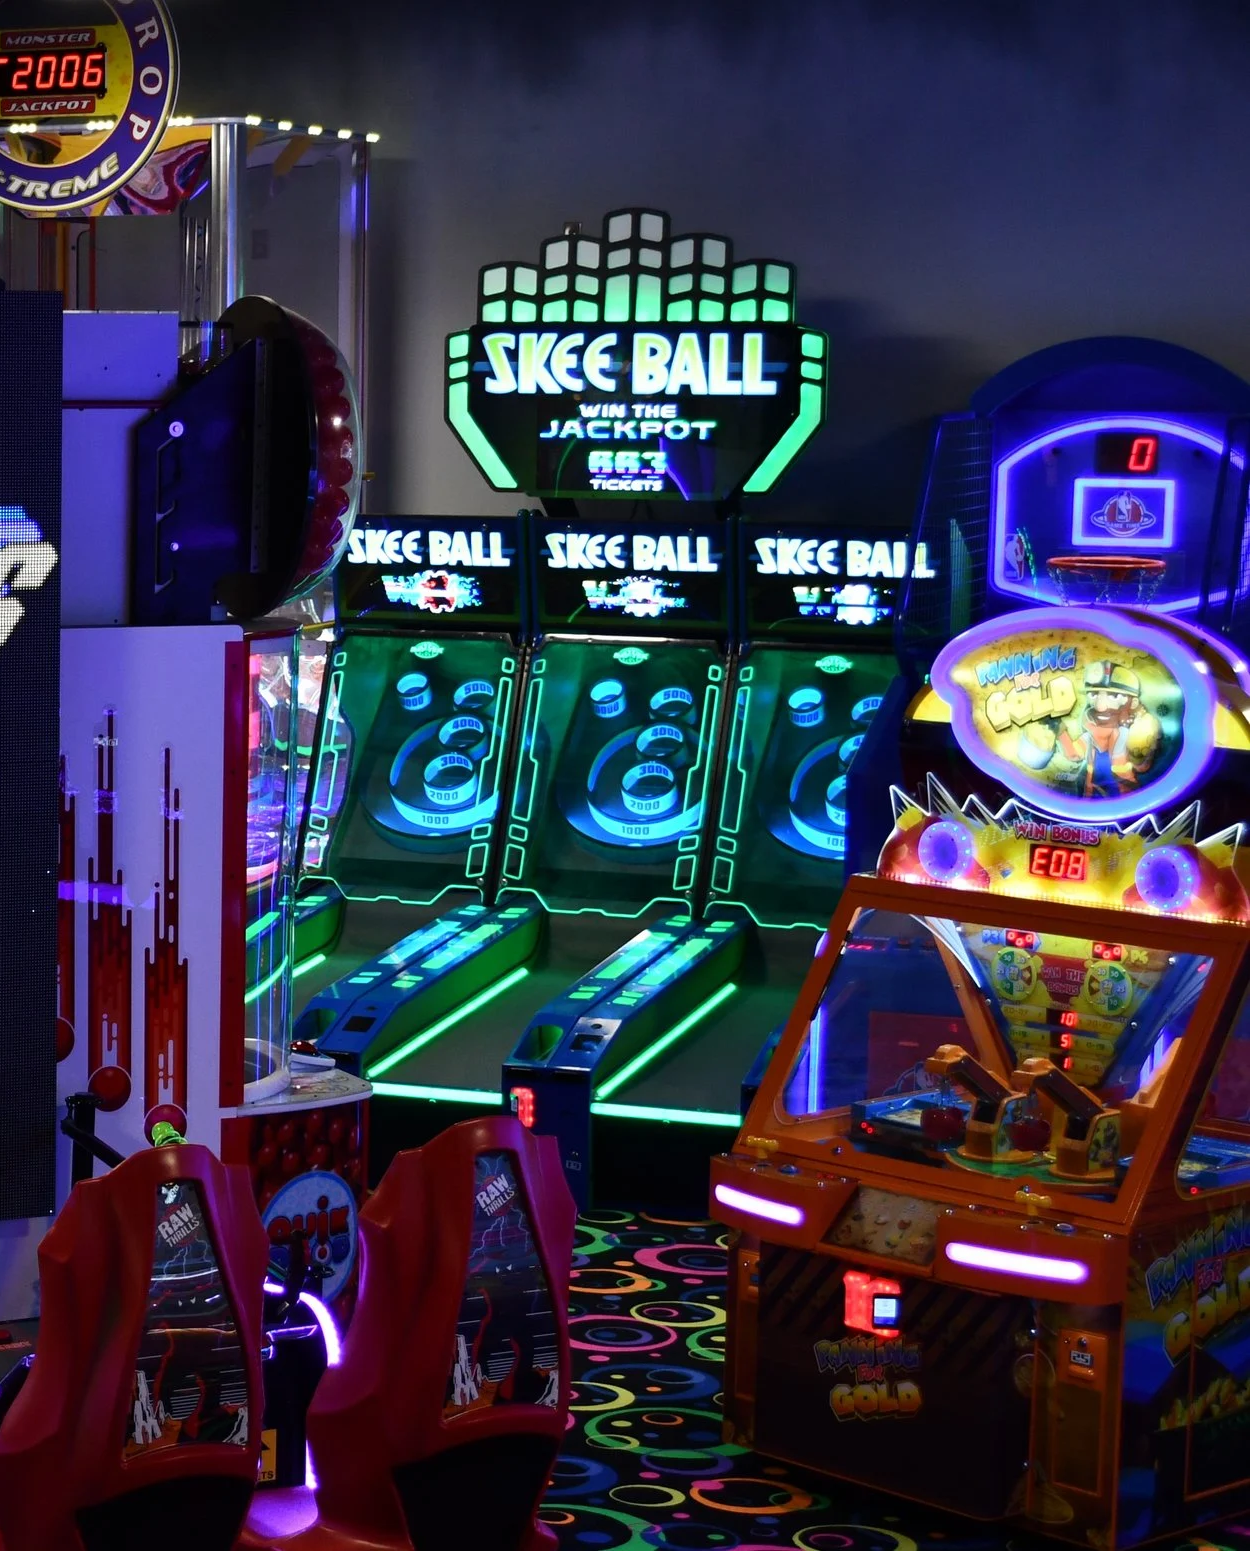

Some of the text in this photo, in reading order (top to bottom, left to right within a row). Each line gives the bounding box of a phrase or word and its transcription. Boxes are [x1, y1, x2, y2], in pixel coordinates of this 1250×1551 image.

[5, 32, 91, 46] MONSTER
[5, 99, 91, 113] JACKPOT
[482, 332, 777, 396] SKEE BALL
[579, 403, 678, 419] WIN THE
[539, 419, 718, 440] JACKPOT
[589, 479, 664, 491] TICKETS
[347, 529, 511, 567] SKEE BALL
[545, 533, 718, 572] SKEE BALL
[755, 537, 839, 575] SKEE
[464, 682, 492, 695] 5000
[663, 689, 692, 703] 5000
[985, 675, 1077, 733] GOLD
[452, 718, 481, 731] 4000
[651, 727, 680, 739] 4000
[440, 756, 469, 768] 3000
[639, 764, 669, 777] 3000
[429, 790, 459, 802] 2000
[630, 799, 660, 811] 2000
[421, 814, 449, 825] 1000
[622, 825, 650, 836] 1000
[1013, 818, 1101, 846] WIN BONUS
[826, 837, 845, 848] 100
[1031, 848, 1085, 879] E08
[1059, 1012, 1075, 1027] 10
[1061, 1033, 1070, 1048] 5
[476, 1174, 510, 1209] RAW
[483, 1188, 515, 1216] THRILLS
[158, 1203, 194, 1240] RAW
[166, 1216, 200, 1248] THRILLS
[830, 1380, 924, 1422] GOLD
